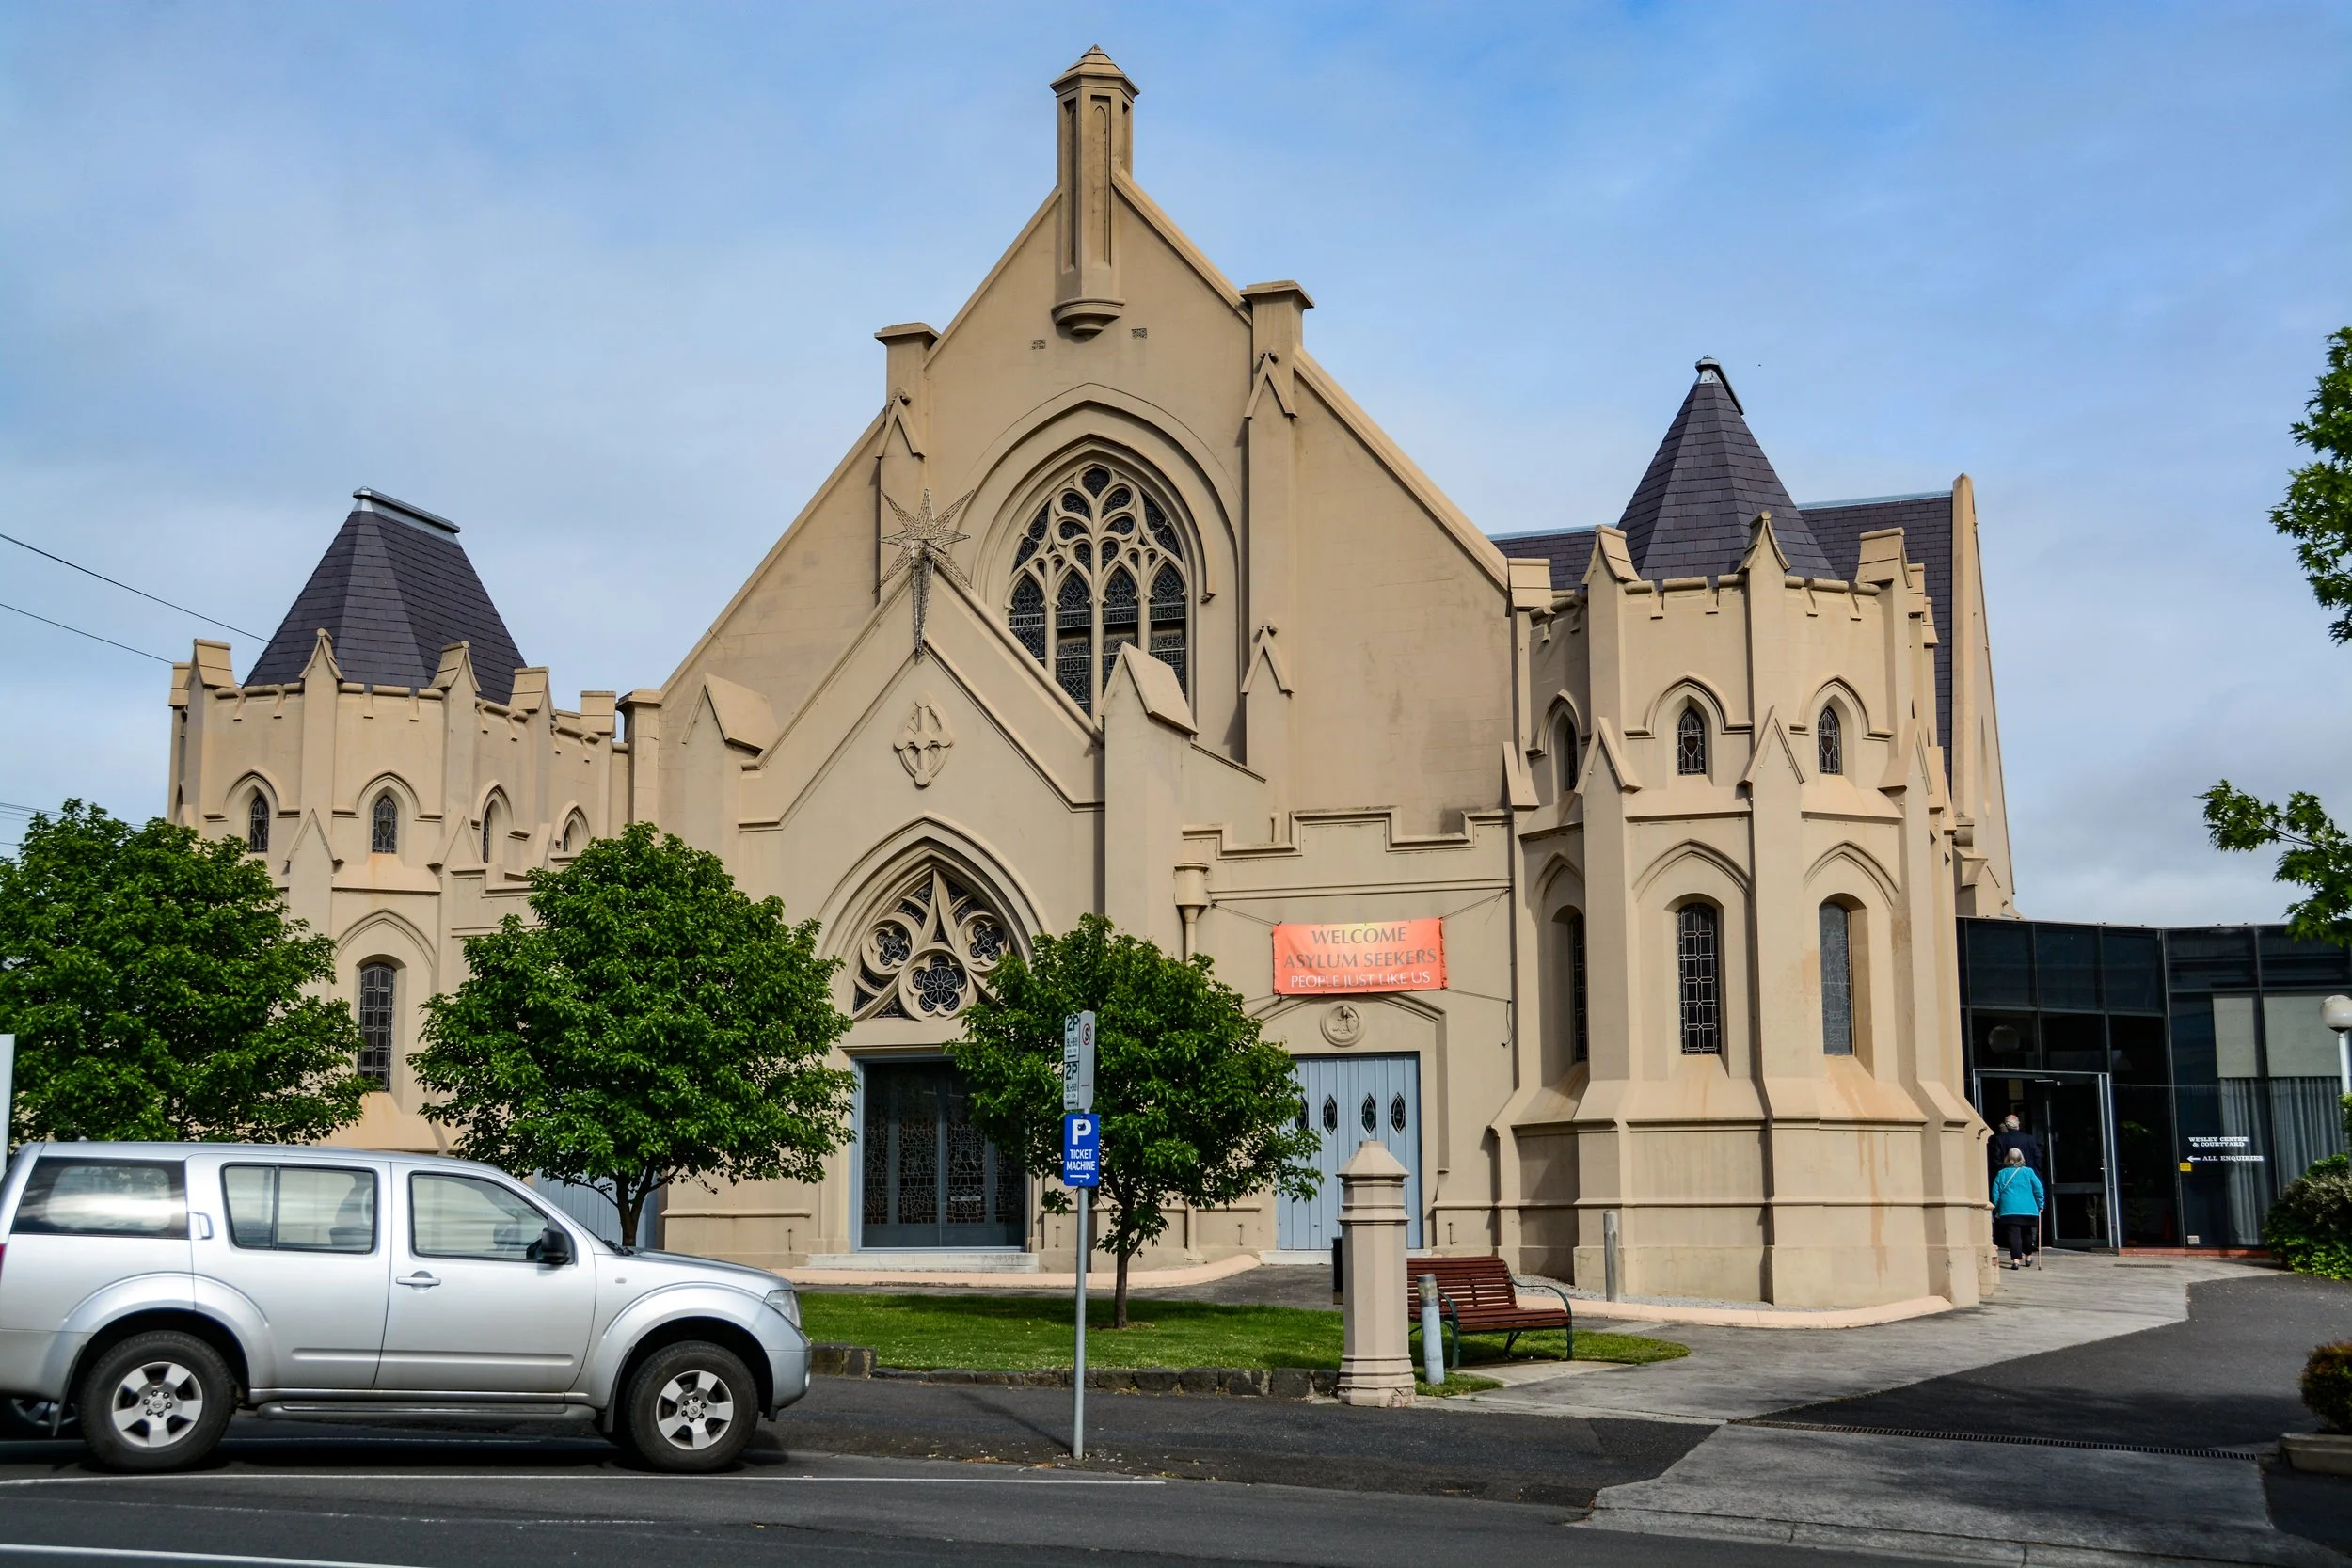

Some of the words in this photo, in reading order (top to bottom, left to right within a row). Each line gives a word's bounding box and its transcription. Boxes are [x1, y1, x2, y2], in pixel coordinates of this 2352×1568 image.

[1311, 927, 1406, 944] WELCOME
[1284, 953, 1359, 969] ASYLUM
[1363, 948, 1438, 968] SEEKERS
[1291, 974, 1339, 988] PEOPLE
[1343, 974, 1375, 988] JUST
[1379, 973, 1406, 985] LIKE
[1410, 971, 1430, 984] US
[1067, 1015, 1079, 1031] 2P
[1066, 1063, 1077, 1080] 2P
[1073, 1119, 1091, 1145] P
[1070, 1149, 1092, 1159] TICKET
[1066, 1161, 1095, 1171] MACHINE
